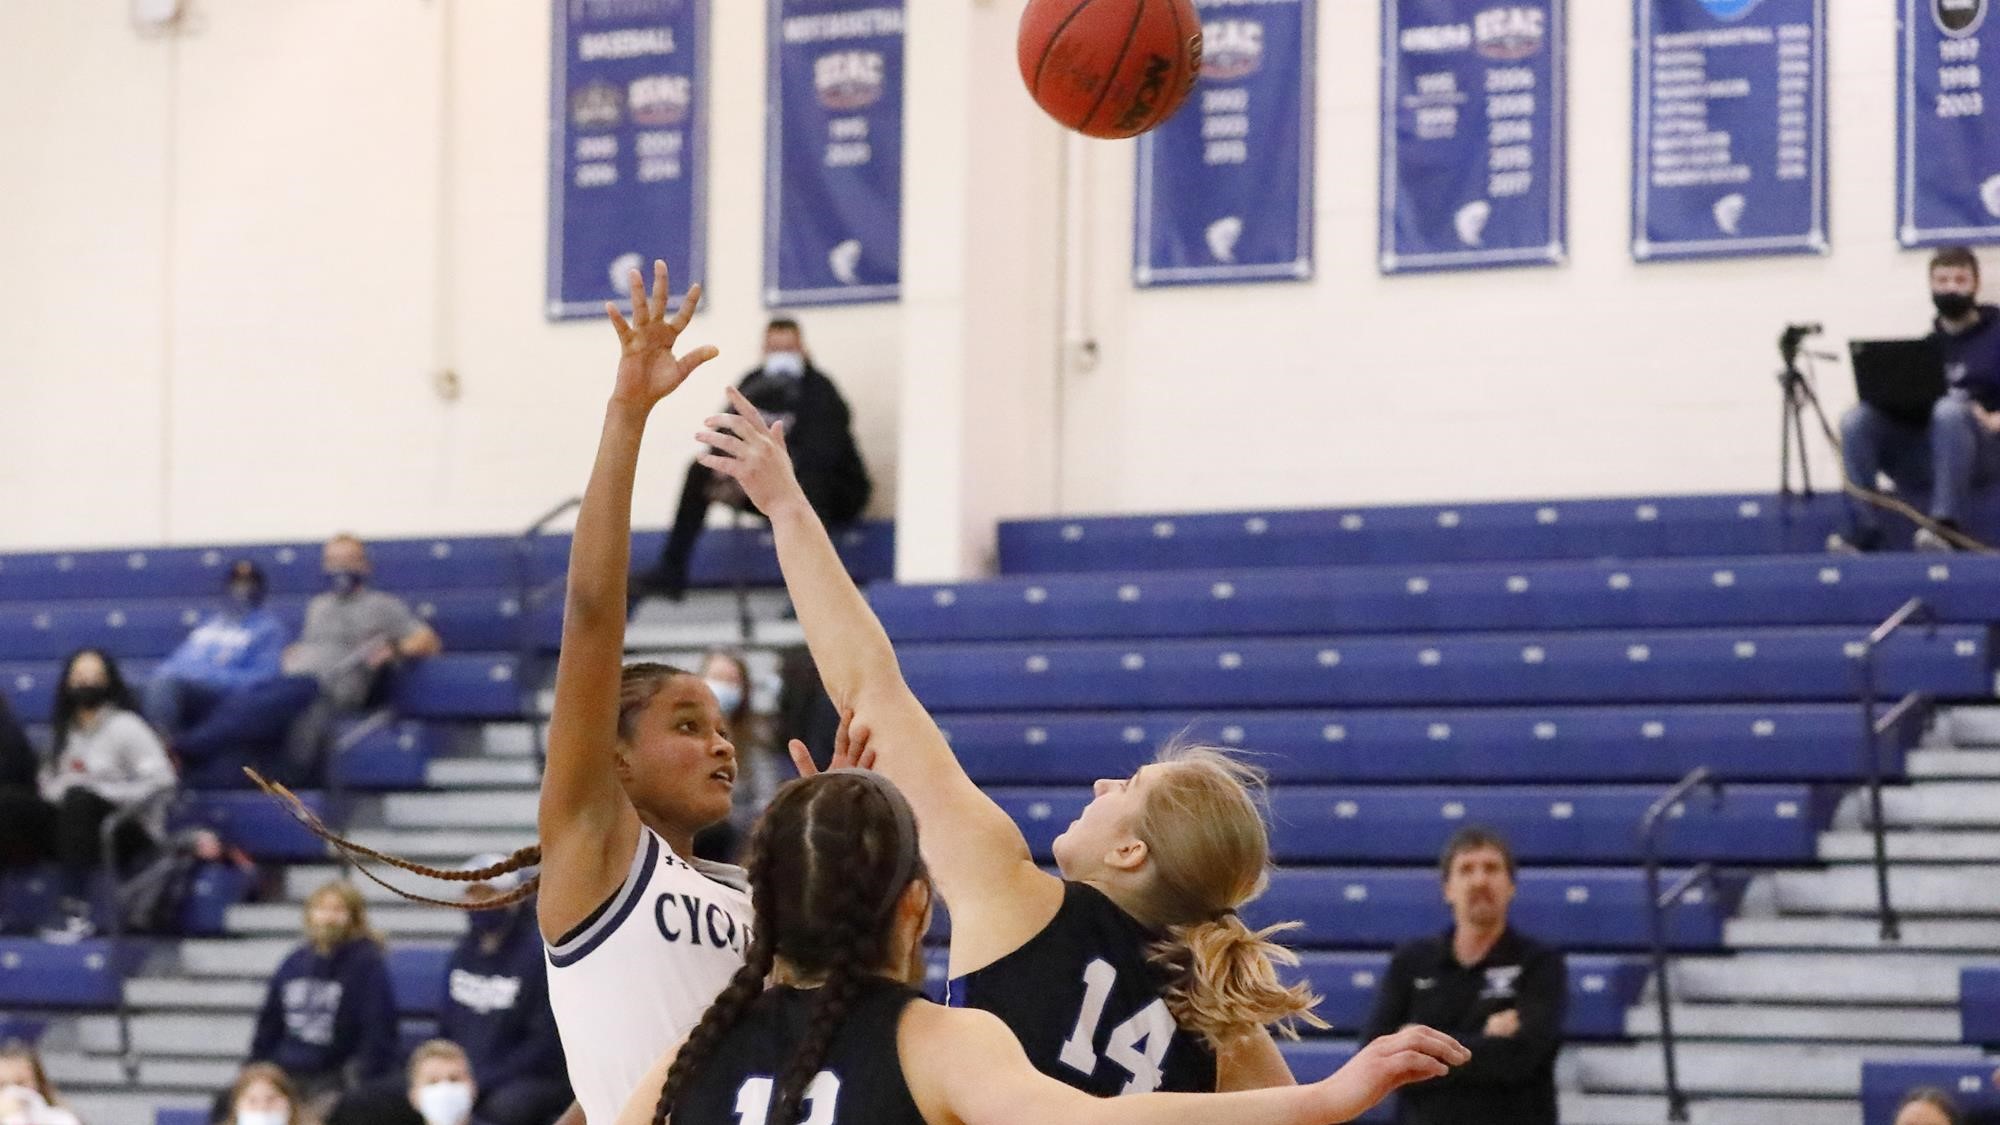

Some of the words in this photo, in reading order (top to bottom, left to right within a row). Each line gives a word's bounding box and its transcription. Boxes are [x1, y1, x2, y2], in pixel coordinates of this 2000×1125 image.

[579, 28, 674, 60] BASEBALL
[814, 51, 883, 88] ECAC
[1059, 958, 1177, 1096] 14
